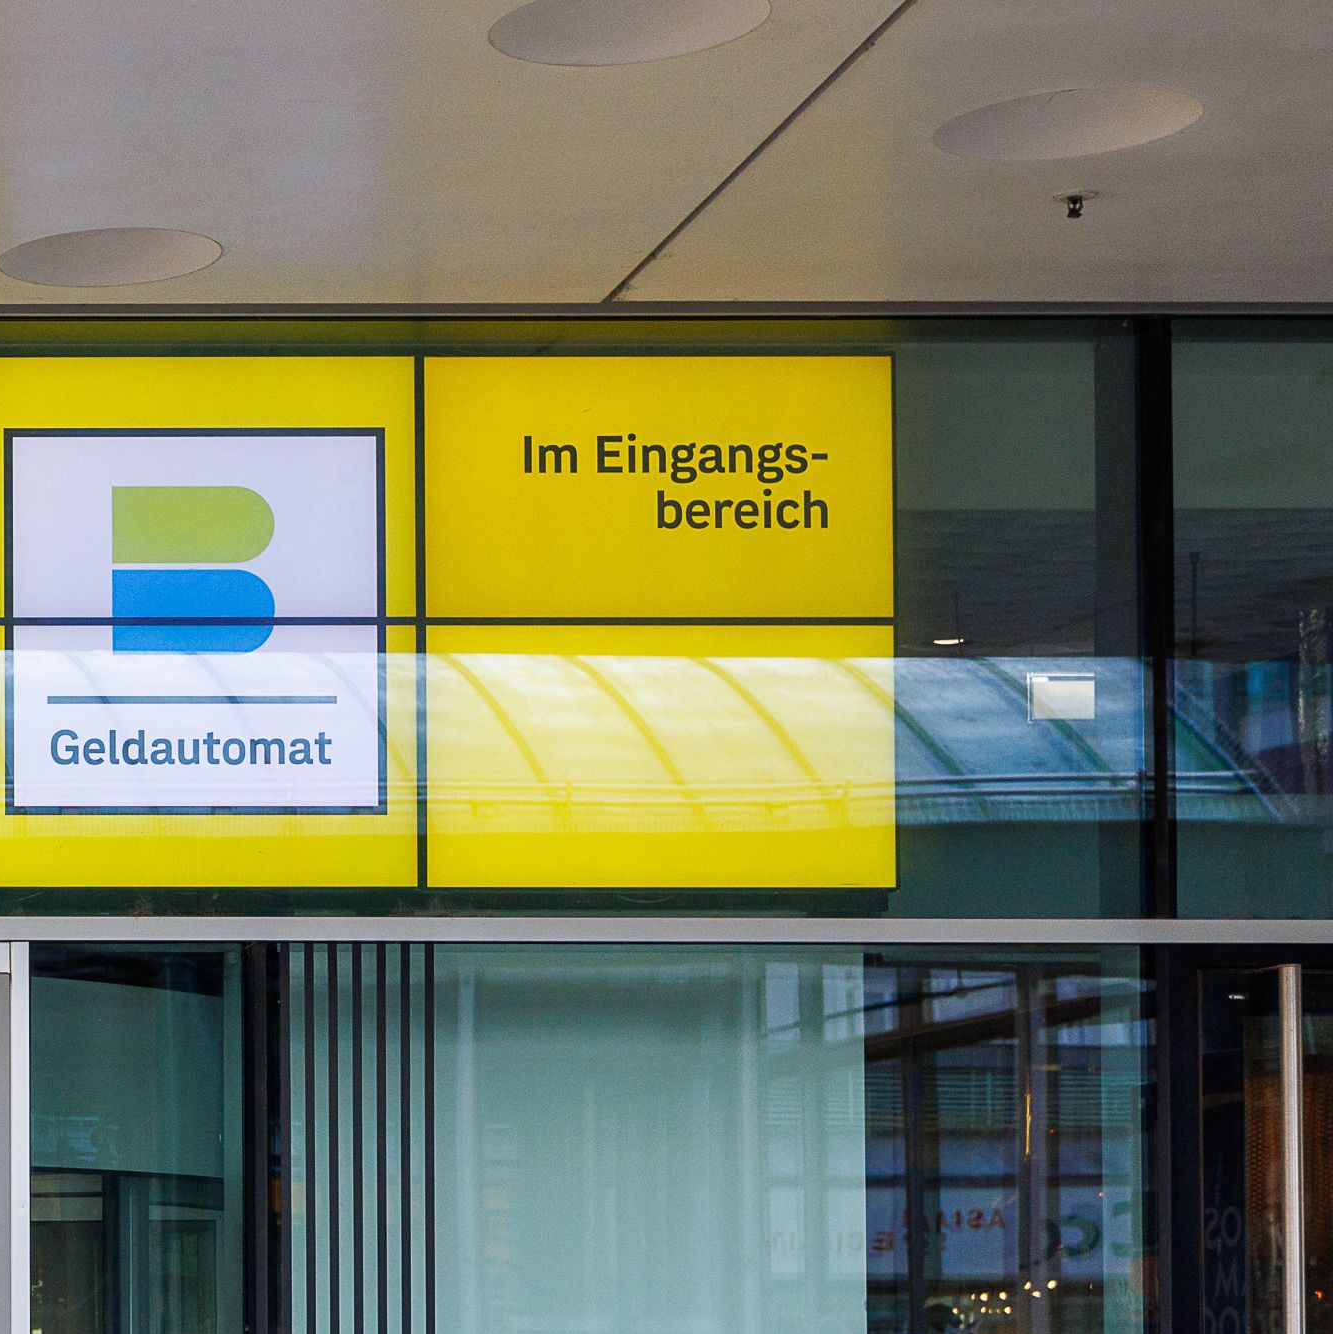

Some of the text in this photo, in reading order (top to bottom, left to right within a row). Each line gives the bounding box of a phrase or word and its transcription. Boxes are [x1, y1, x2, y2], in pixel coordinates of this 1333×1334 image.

[522, 433, 829, 484] Im Eingangs-
[656, 489, 829, 530] bereich
[49, 729, 333, 768] Geldautomat
